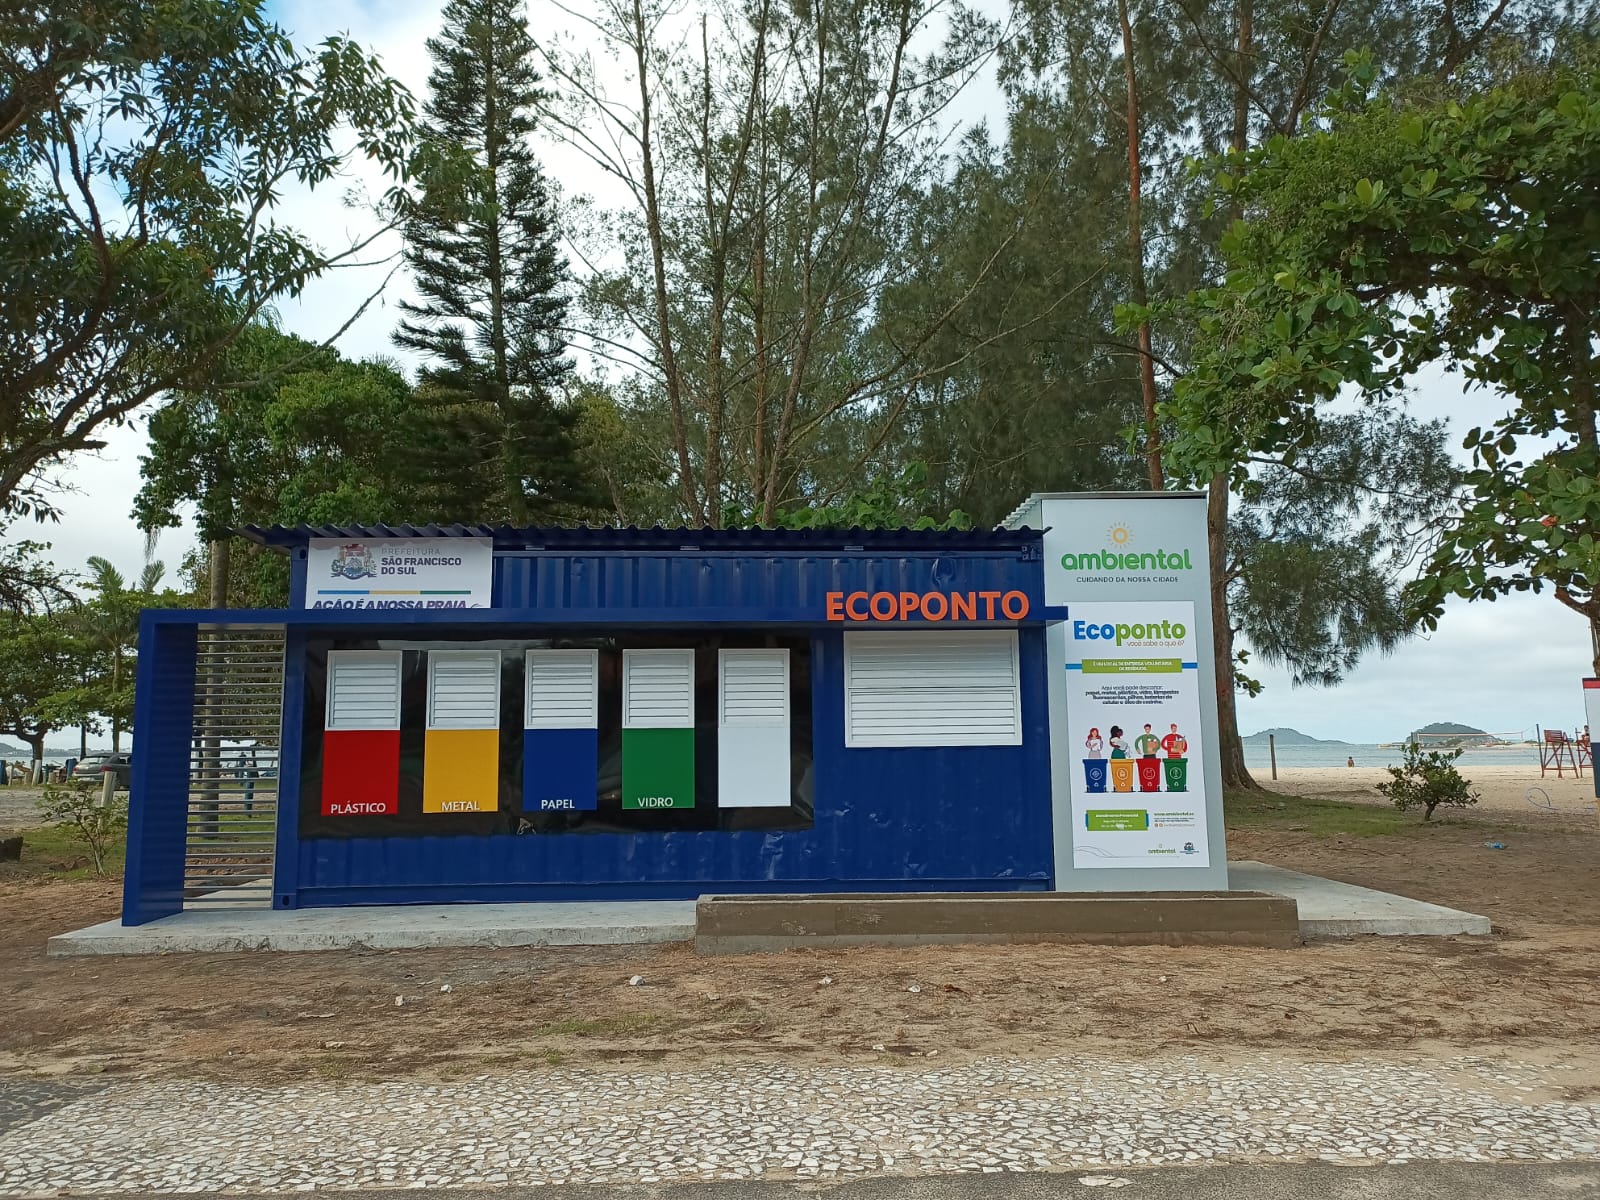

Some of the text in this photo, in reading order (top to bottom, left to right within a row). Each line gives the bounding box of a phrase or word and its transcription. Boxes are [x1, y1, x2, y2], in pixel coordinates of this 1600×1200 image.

[381, 547, 441, 556] PREFEITURA
[381, 556, 462, 566] SÃO FRANCISCO
[1061, 549, 1193, 571] ambiental
[381, 567, 417, 575] DO SUL
[826, 590, 1030, 621] ECOPONTO
[1073, 620, 1186, 647] Ecoponto
[441, 801, 480, 811] METAL
[541, 799, 575, 810] PAPEL
[637, 797, 673, 807] VIDRO
[330, 801, 387, 814] PLÁSTICO
